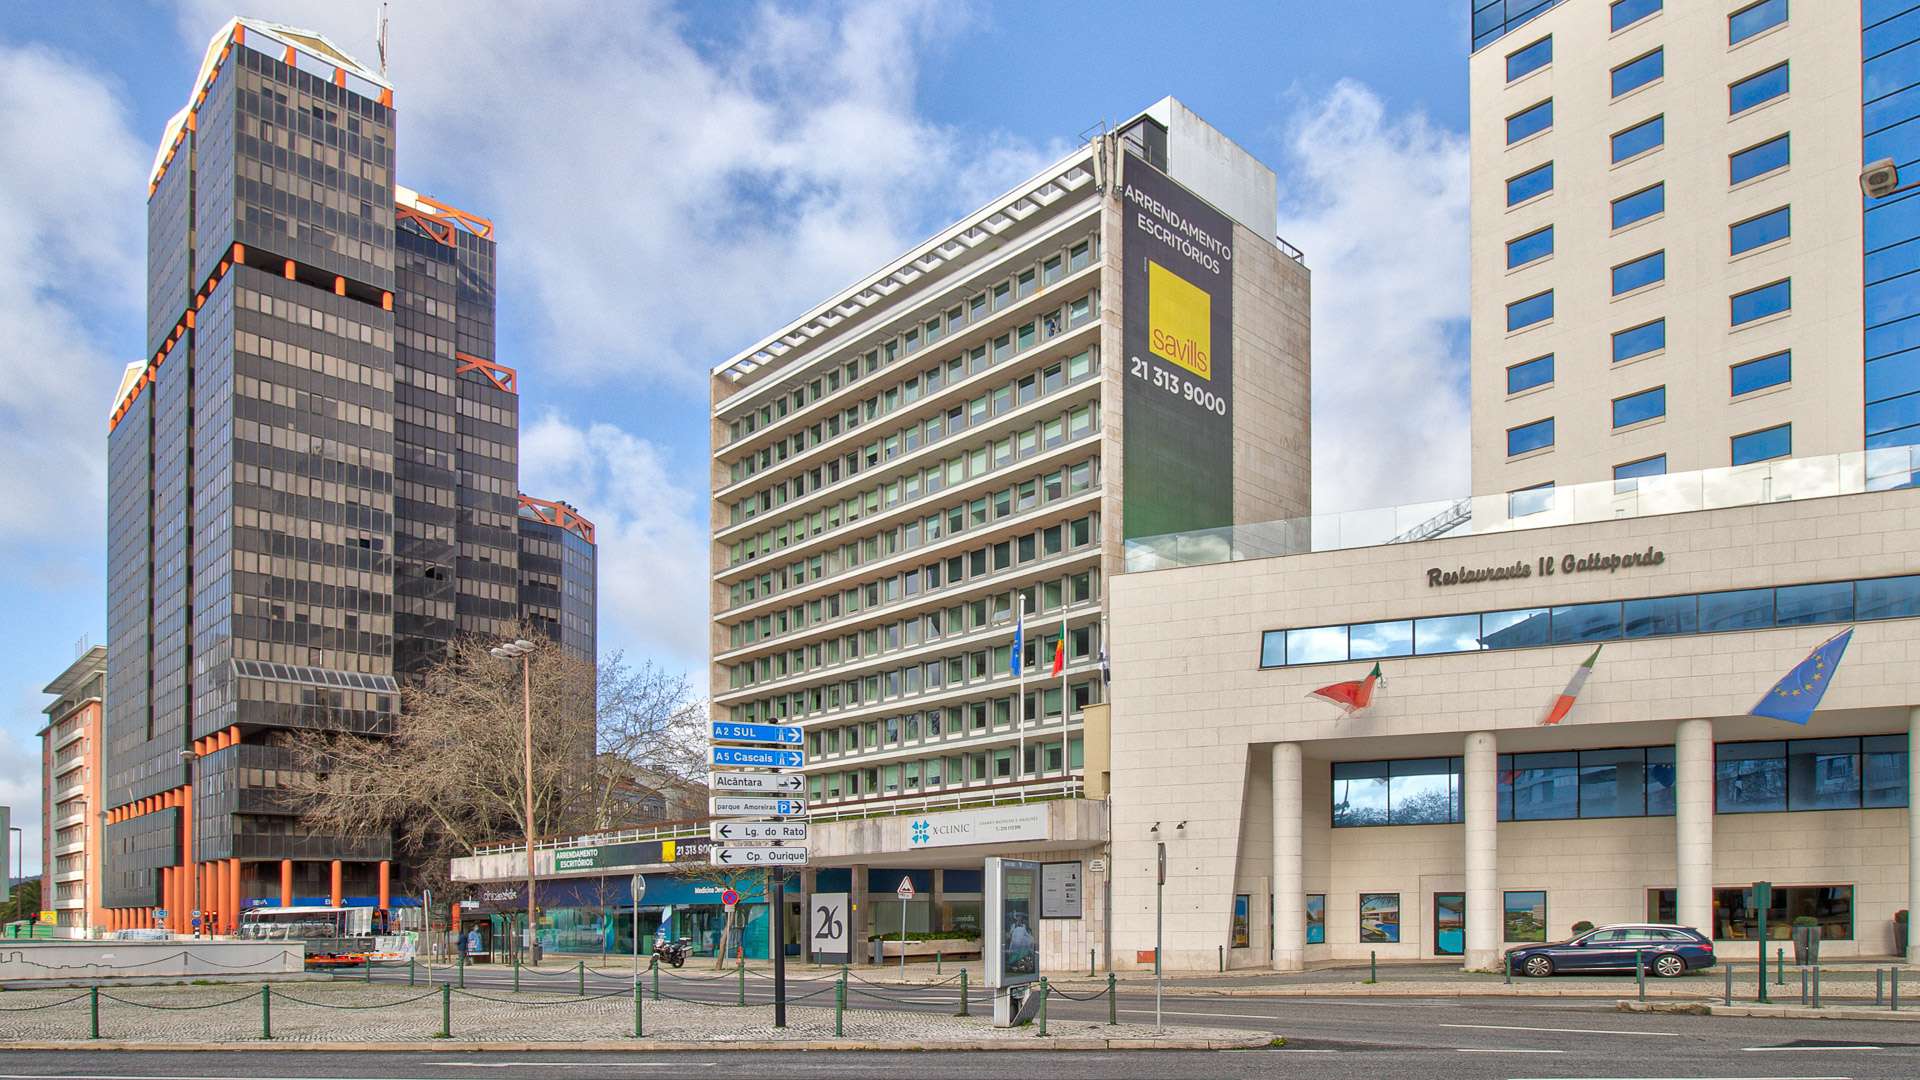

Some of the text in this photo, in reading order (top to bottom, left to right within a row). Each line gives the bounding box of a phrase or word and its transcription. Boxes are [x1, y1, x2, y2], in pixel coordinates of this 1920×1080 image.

[1124, 184, 1231, 261] ARRENDAMENTO
[1138, 213, 1220, 274] ESCRITÓRIOS
[1153, 328, 1208, 373] savills
[1130, 356, 1226, 416] 21 313 9000
[1427, 560, 1532, 588] Restaurante
[1561, 546, 1665, 574] Gattopardo
[715, 727, 756, 737] A2 SUL
[716, 752, 773, 763] A5 Cascais
[717, 776, 762, 787] Alcântara
[744, 803, 776, 811] Amoreiras
[745, 827, 804, 838] Lg. do Rato
[746, 851, 805, 862] Cp. Ourique
[814, 905, 843, 940] 26
